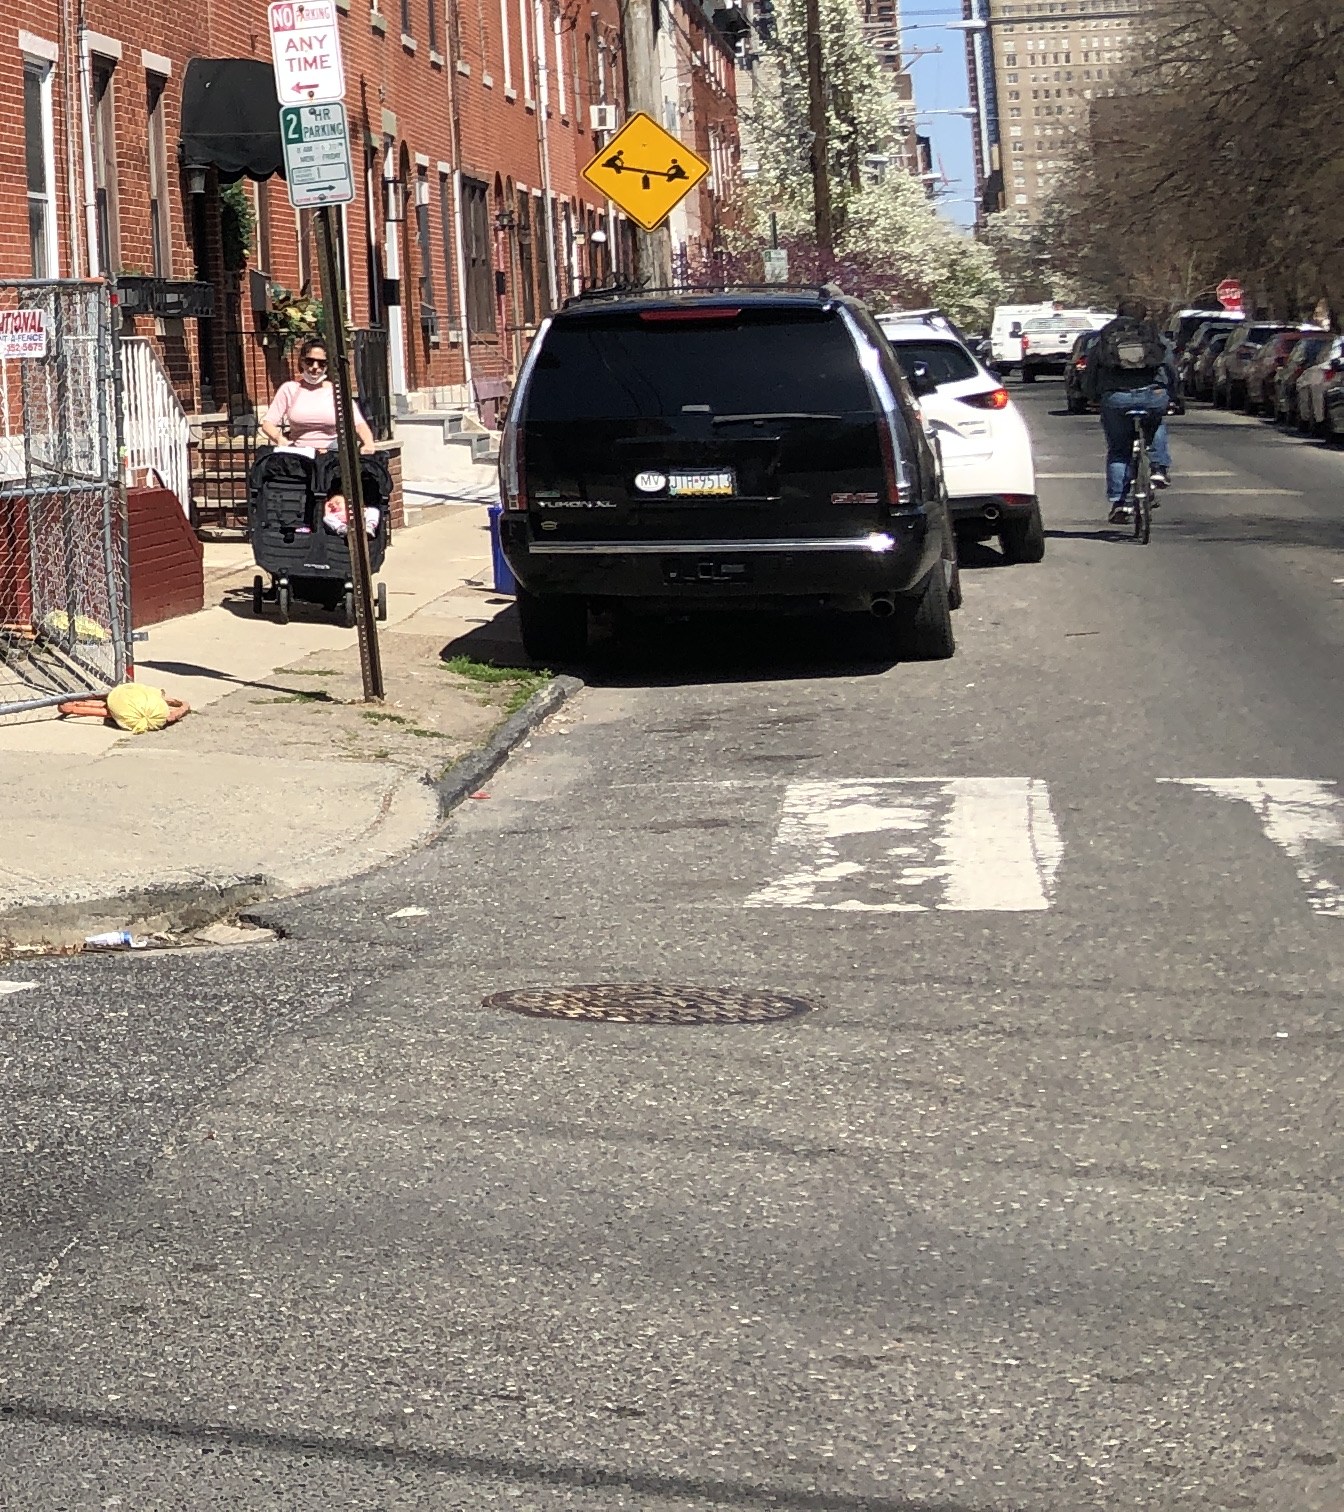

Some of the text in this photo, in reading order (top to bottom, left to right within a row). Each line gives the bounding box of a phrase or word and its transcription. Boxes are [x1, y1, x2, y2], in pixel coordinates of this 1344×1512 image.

[273, 7, 293, 28] NO
[285, 34, 327, 53] ANY
[285, 54, 332, 72] TIME
[286, 108, 331, 139] 2 HR
[303, 122, 343, 138] PARKING
[640, 474, 660, 487] MV
[594, 500, 617, 508] XL
[831, 492, 880, 504] GMC
